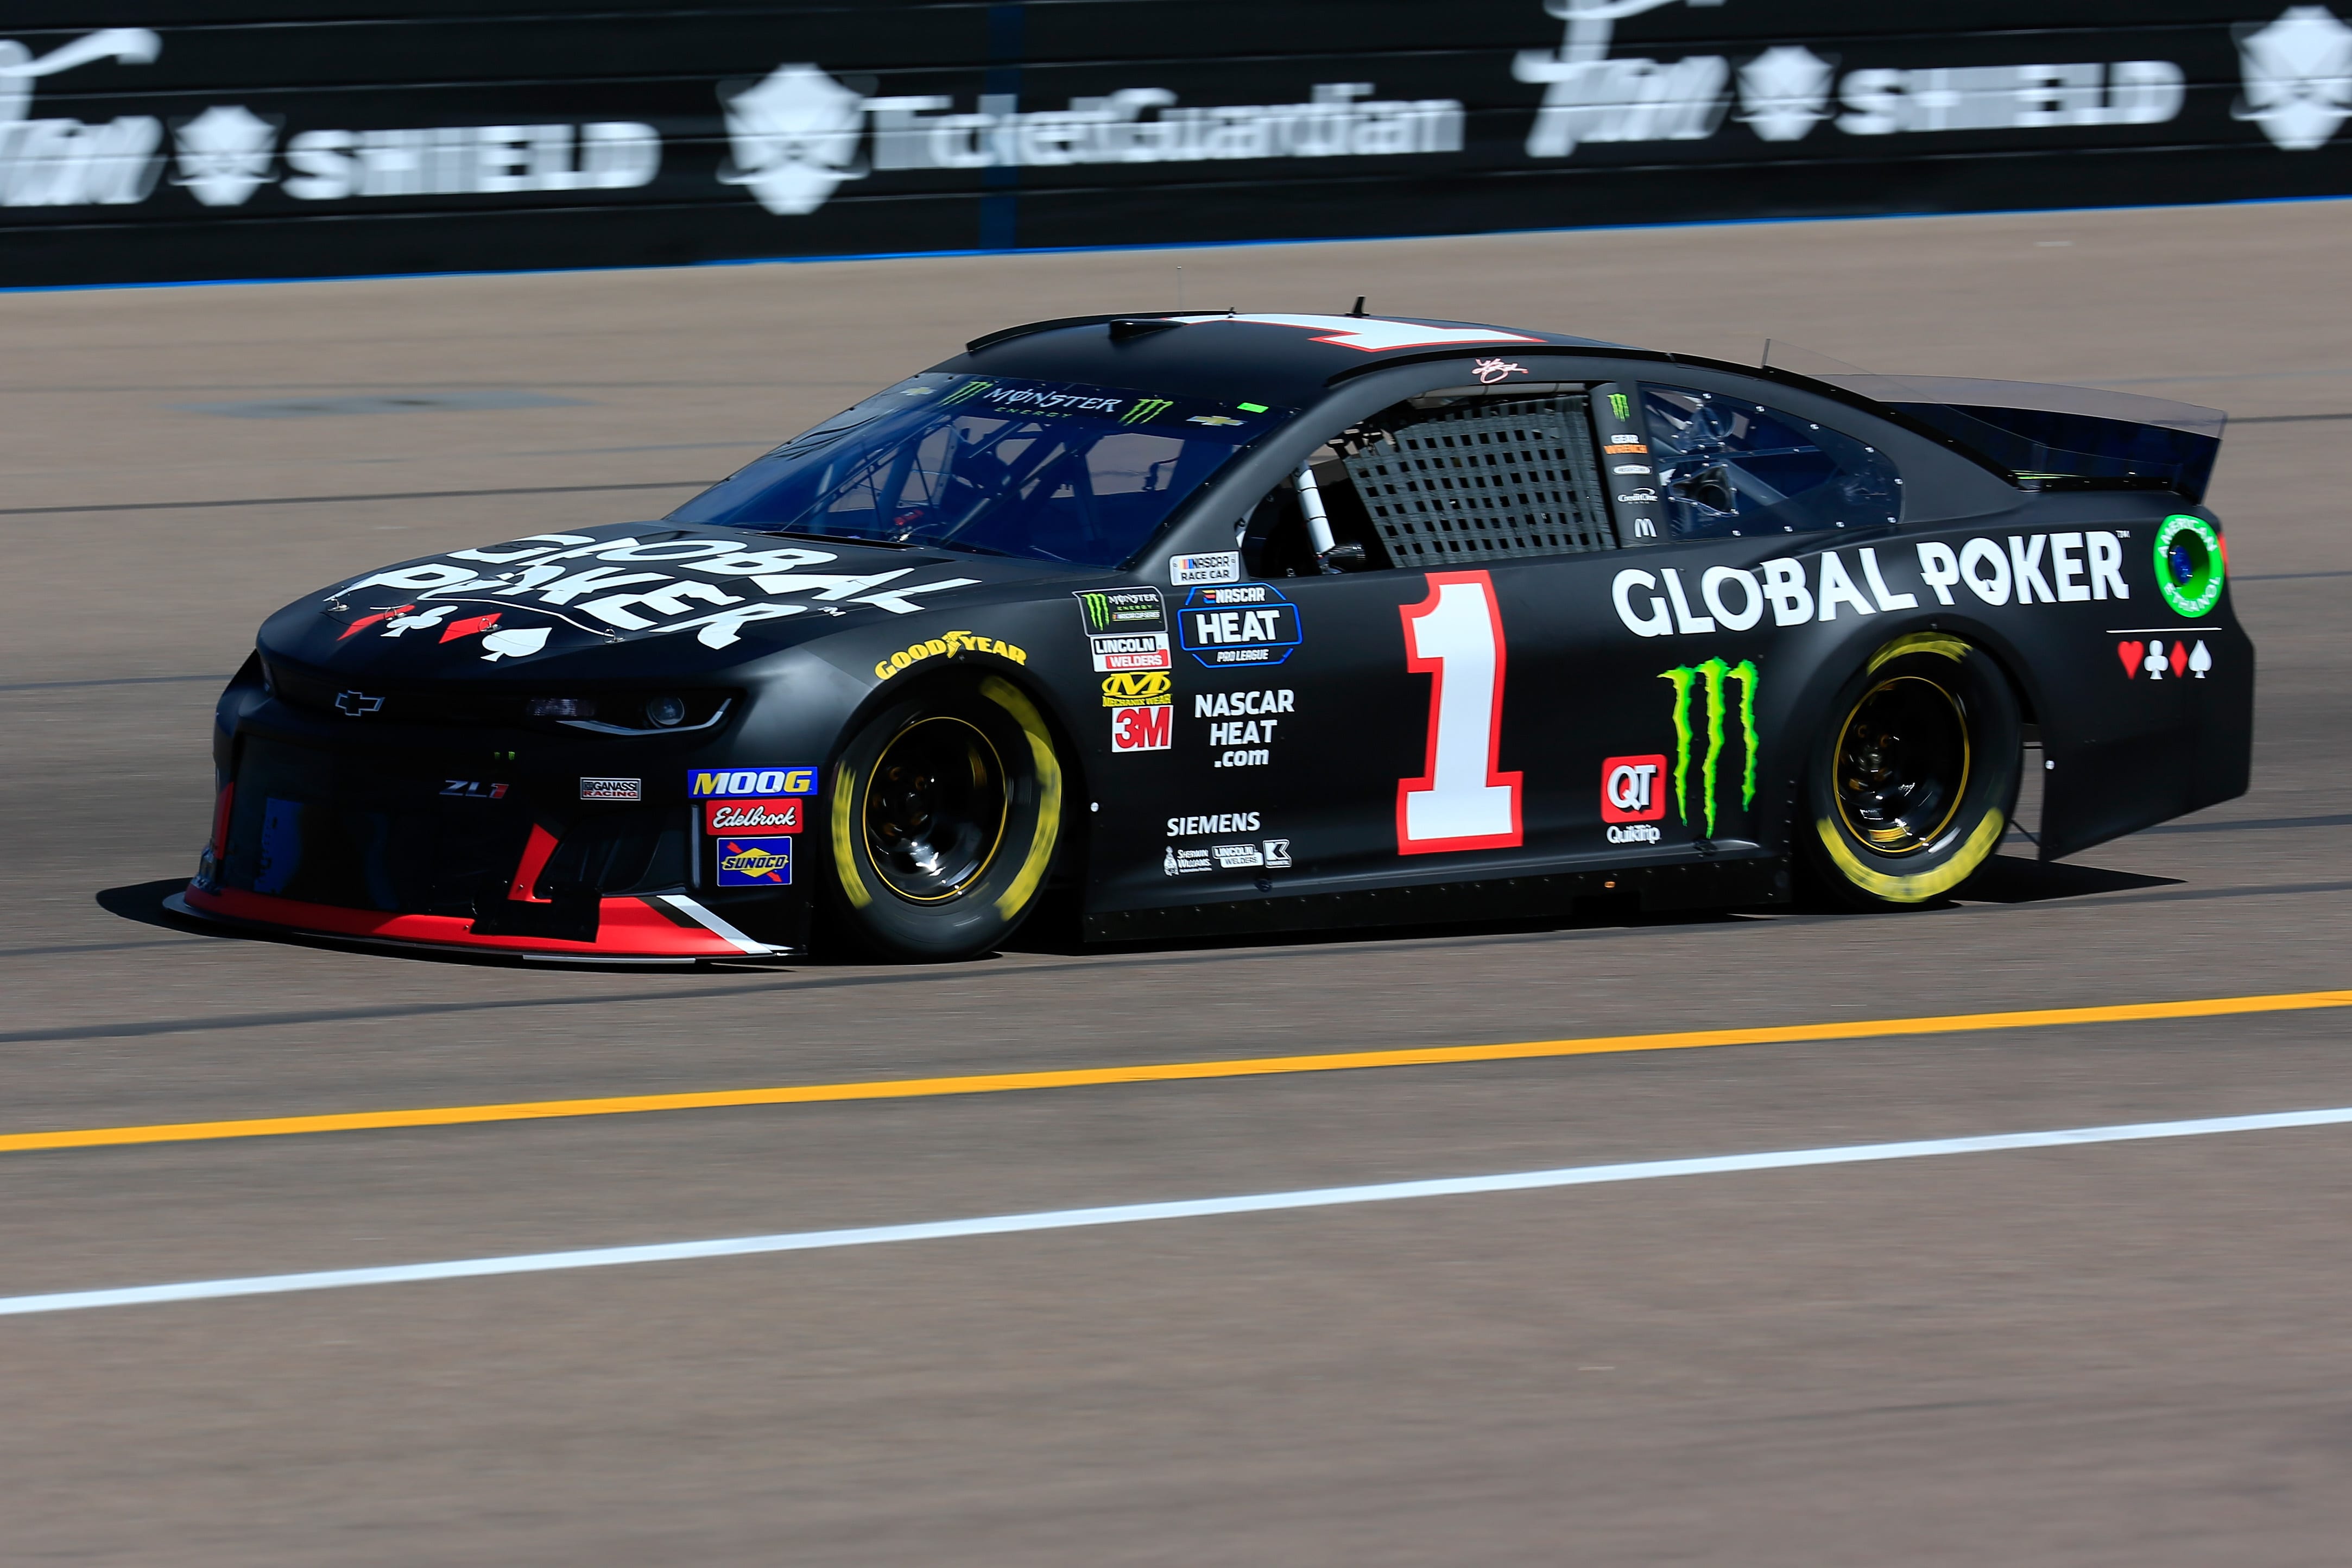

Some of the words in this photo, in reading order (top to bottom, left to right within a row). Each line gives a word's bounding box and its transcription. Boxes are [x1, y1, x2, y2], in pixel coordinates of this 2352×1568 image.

[1835, 60, 2187, 135] SHIELD
[860, 83, 1465, 169] TicketGuardian
[281, 122, 662, 200] SHIELD
[995, 407, 1073, 418] ENERGY
[2158, 517, 2218, 558] AMERICAN
[1192, 557, 1229, 568] NASCAR
[1181, 571, 1207, 580] RACE
[1210, 570, 1230, 579] CAR
[1611, 547, 1919, 638] GLOBAL
[1921, 531, 2129, 606] POKER
[1216, 587, 1265, 604] NASCAR
[2164, 577, 2221, 612] ETHANOL
[1196, 610, 1280, 644] HEAT
[874, 632, 1028, 681] GOODYEAR
[1095, 637, 1156, 654] LINCOLN
[1217, 651, 1235, 662] PRO
[1236, 649, 1269, 661] LEAGUE
[1110, 655, 1163, 667] WELDERS
[1102, 696, 1145, 707] MECHANIX
[1146, 694, 1172, 705] WEAR
[1195, 689, 1295, 718] NASCAR
[1396, 570, 1523, 856] 1
[1115, 706, 1170, 749] 3M
[1210, 719, 1278, 746] HEAT
[1214, 749, 1269, 768] .com
[439, 780, 509, 799] ZL1
[593, 782, 637, 791] GANASSI
[693, 771, 813, 795] MOOG
[1607, 764, 1657, 811] QT
[713, 806, 796, 829] Edelbrock
[1167, 812, 1261, 837] SIEMENS
[1607, 824, 1661, 844] QuikTrip
[725, 856, 787, 869] SUNOCO
[1215, 846, 1254, 857] LINCOLN
[1226, 857, 1257, 865] WELDERS
